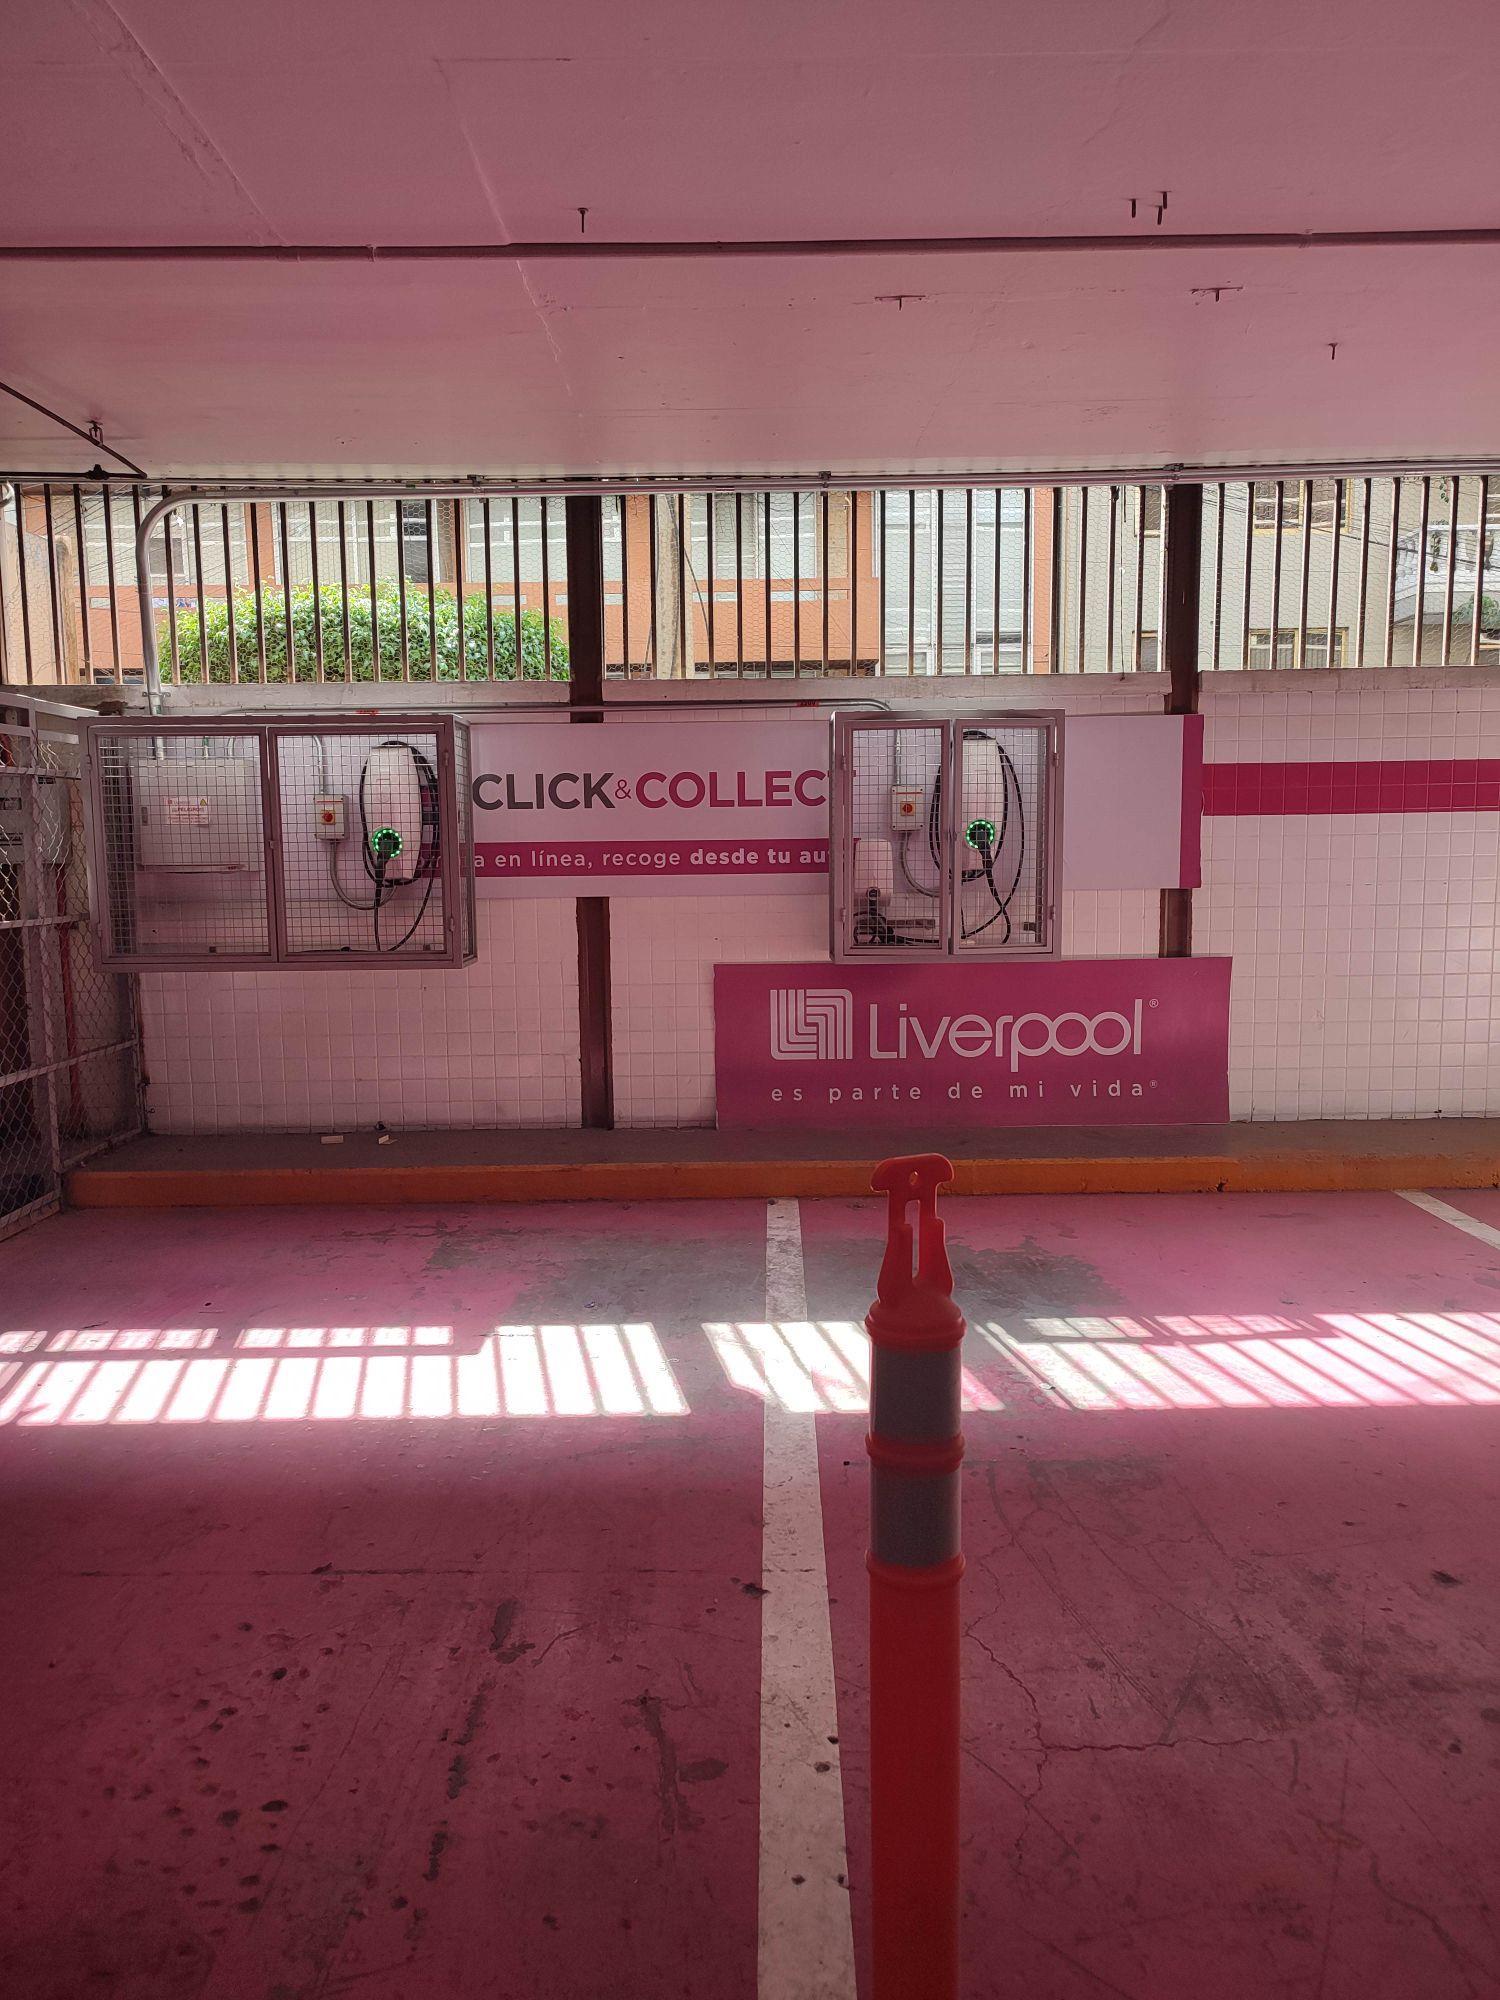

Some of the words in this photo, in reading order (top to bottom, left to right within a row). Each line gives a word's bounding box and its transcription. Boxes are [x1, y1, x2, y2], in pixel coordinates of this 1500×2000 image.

[472, 769, 857, 810] CLICK&COLLEC
[495, 855, 521, 867] en
[531, 850, 593, 868] línea,
[602, 850, 681, 869] recoge
[690, 848, 759, 865] desde
[767, 848, 791, 864] tu
[771, 1087, 803, 1101] es
[829, 1083, 921, 1103] parte
[948, 1082, 983, 1099] de
[1010, 1080, 1043, 1098] mi
